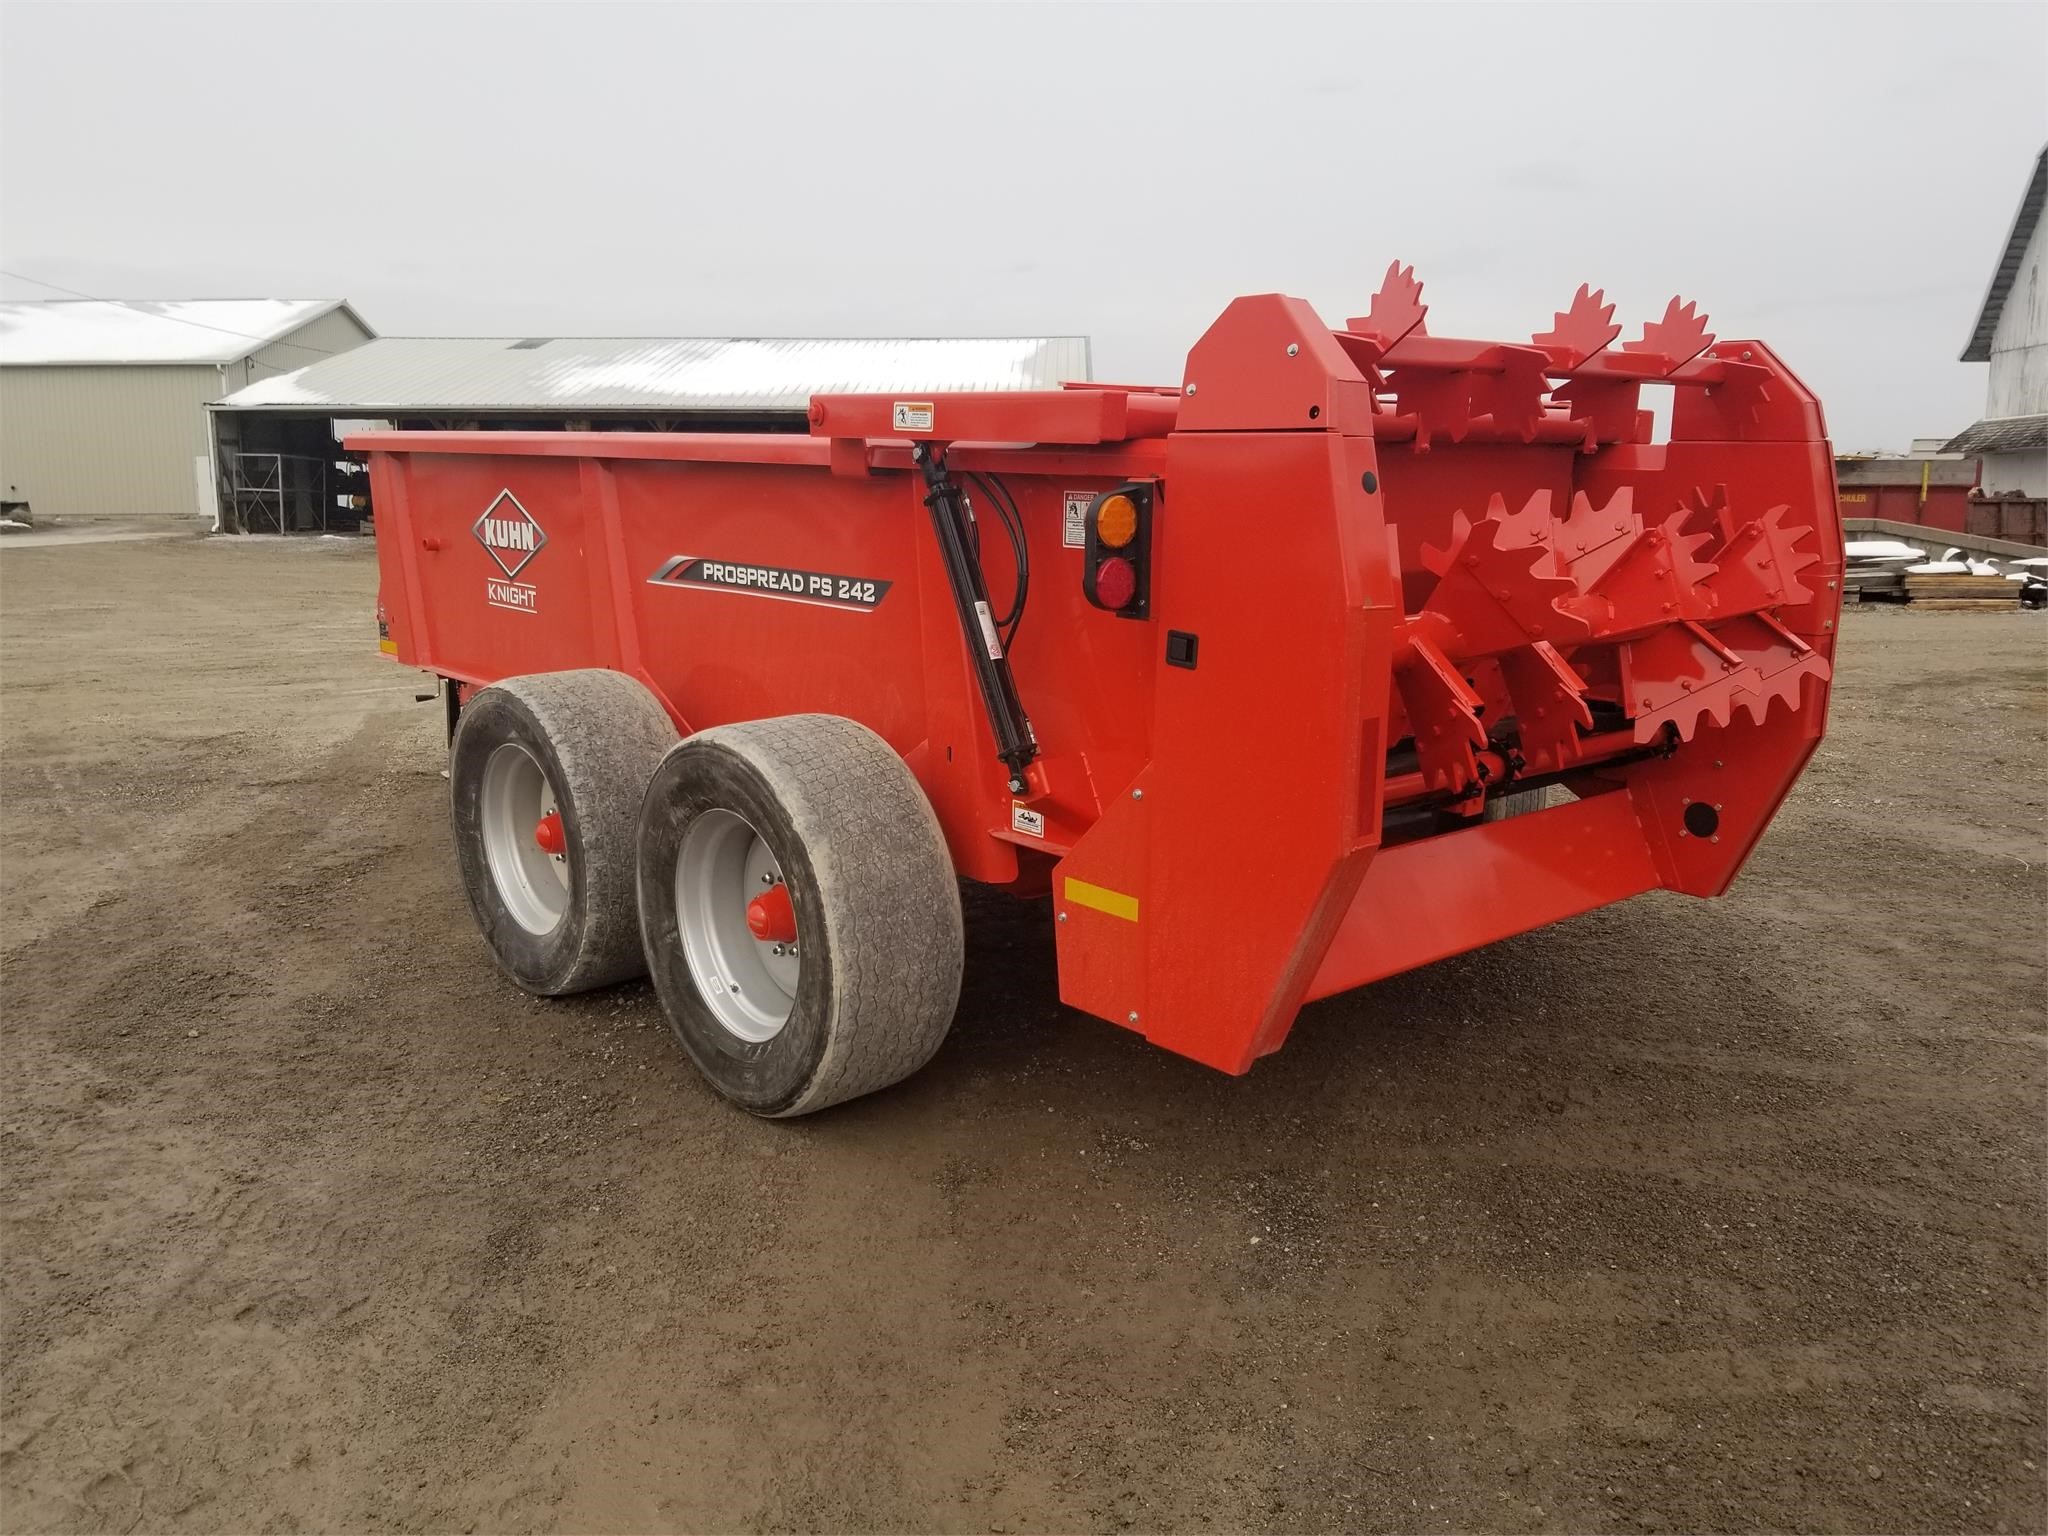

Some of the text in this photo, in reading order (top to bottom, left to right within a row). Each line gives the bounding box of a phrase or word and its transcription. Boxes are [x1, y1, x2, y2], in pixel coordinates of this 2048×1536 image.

[484, 518, 535, 551] KUHN
[487, 583, 537, 607] KNIGHT
[703, 562, 876, 603] PROSPREAD PS 242
